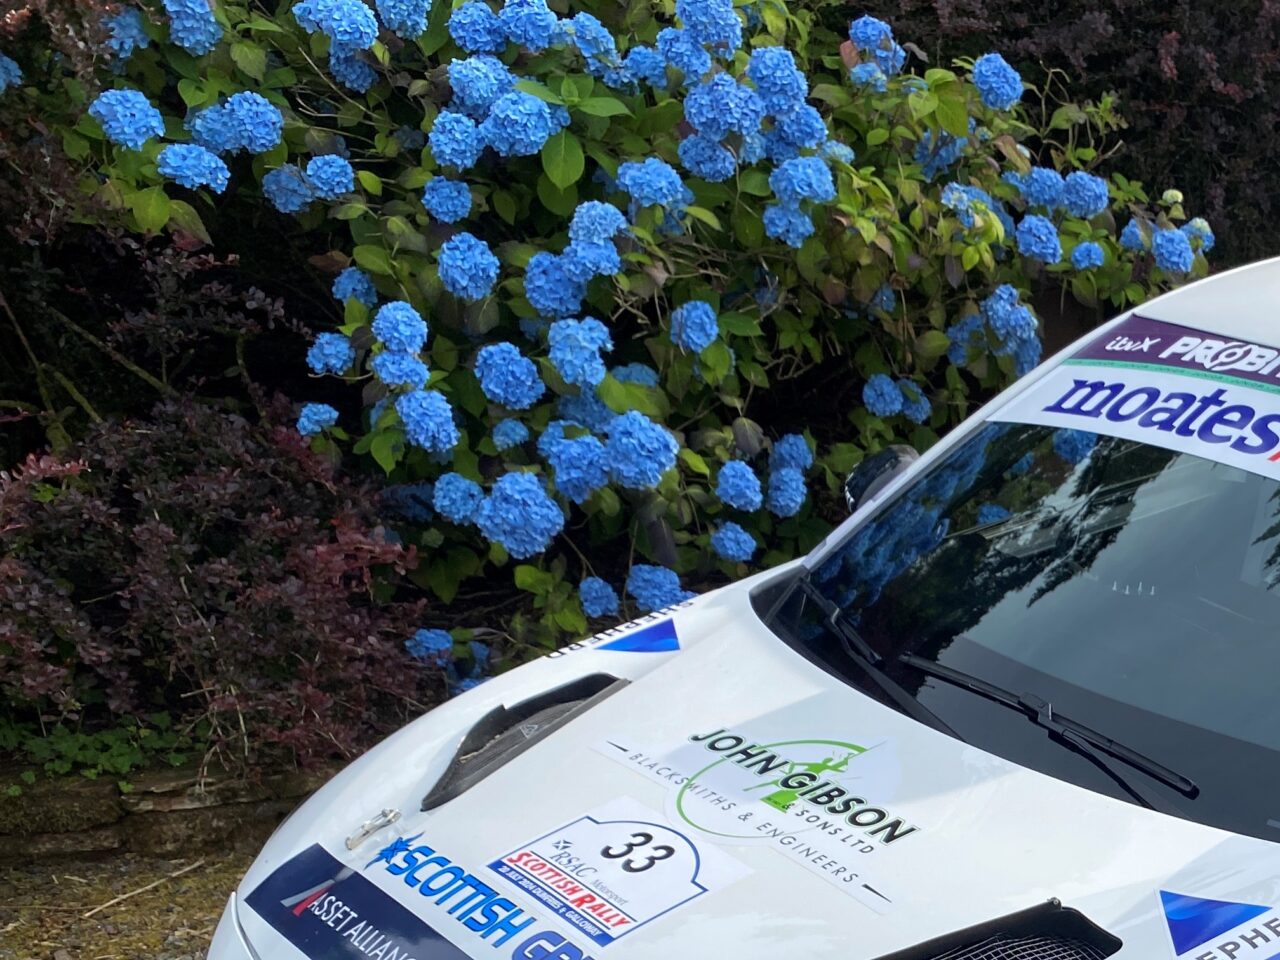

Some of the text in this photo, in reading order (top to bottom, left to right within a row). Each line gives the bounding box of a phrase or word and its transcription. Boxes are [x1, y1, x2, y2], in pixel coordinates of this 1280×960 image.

[689, 728, 918, 846] JOHN GIBSON
[629, 753, 859, 884] BLACKSMITHS & ENGINEERS
[795, 809, 843, 836] SONS
[840, 834, 875, 854] LTD
[549, 851, 598, 878] RSAC
[600, 831, 676, 874] 33
[307, 892, 358, 932] ASSET
[385, 845, 538, 949] SCOTTISH
[506, 851, 632, 928] SCOTTISH RALLY
[565, 910, 602, 937] GALLOWAY
